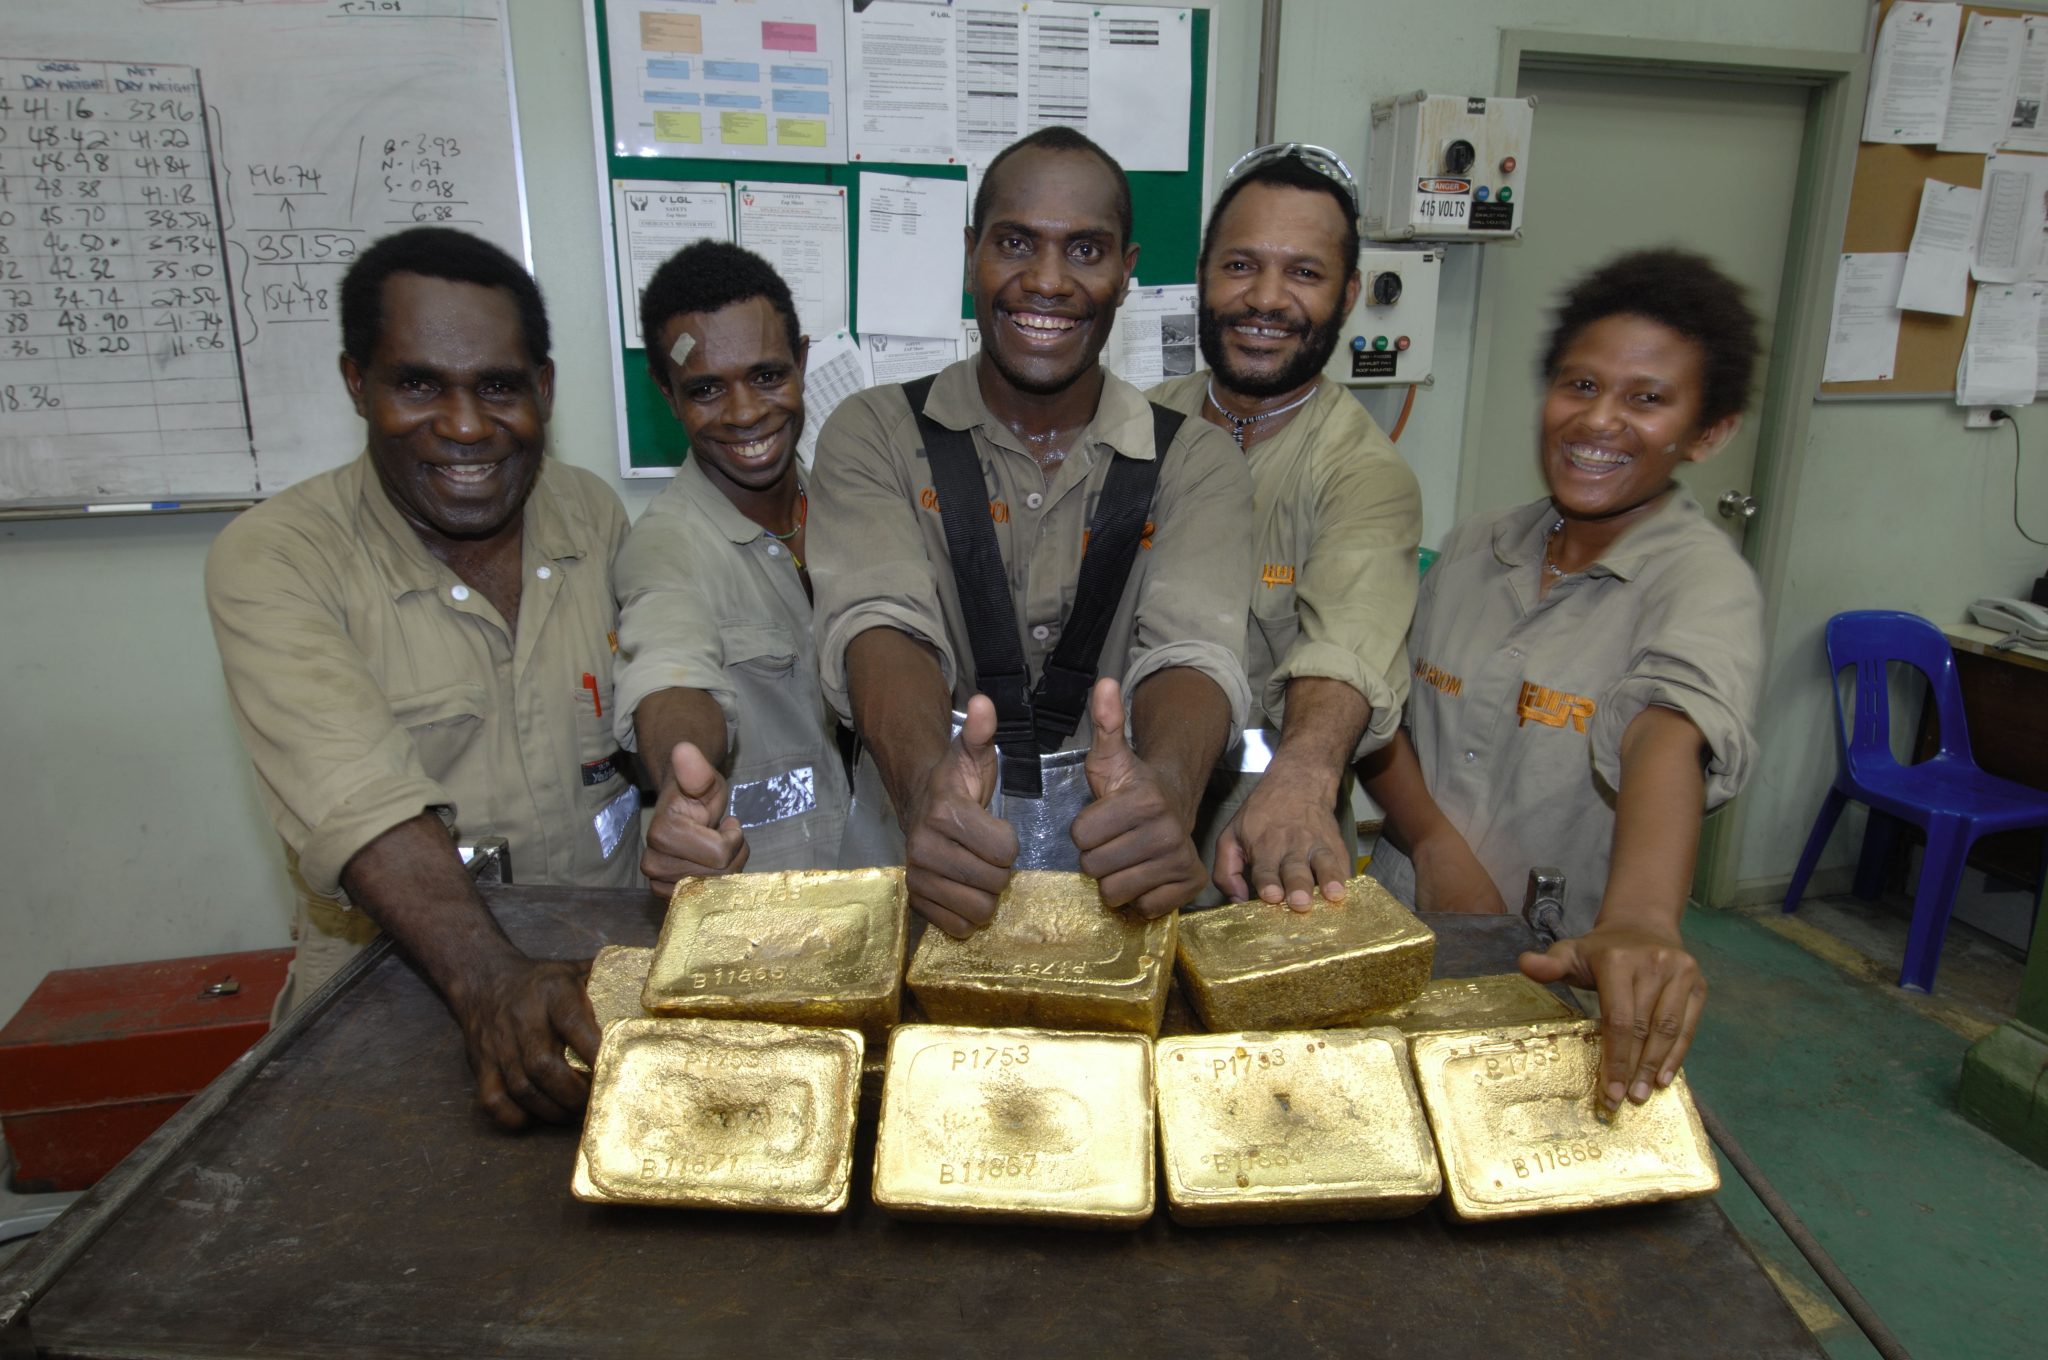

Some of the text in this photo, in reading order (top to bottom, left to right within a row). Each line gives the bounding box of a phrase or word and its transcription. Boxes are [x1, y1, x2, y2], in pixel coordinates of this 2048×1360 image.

[22, 74, 51, 91] DRY
[126, 66, 157, 78] NET
[114, 79, 143, 94] DRY
[129, 128, 190, 149] 41.22
[32, 152, 110, 174] 48.98
[35, 176, 102, 200] 48.38
[248, 163, 322, 192] 196.74
[669, 196, 693, 204] LGL
[1420, 199, 1466, 218] 415 VOLTS
[40, 205, 105, 227] 45.70
[144, 208, 212, 233] 38.54
[253, 233, 356, 262] 351.52
[49, 255, 116, 280] 42.32
[147, 260, 214, 279] 35.10
[57, 309, 129, 335] 48.90
[154, 310, 223, 333] 41.74
[67, 336, 130, 359] 18.20
[952, 1044, 1031, 1072] P1753
[1212, 1048, 1286, 1079] P1753
[640, 1152, 739, 1180] B11871
[940, 1153, 1037, 1185] B11867
[1512, 1139, 1603, 1179] B11868
